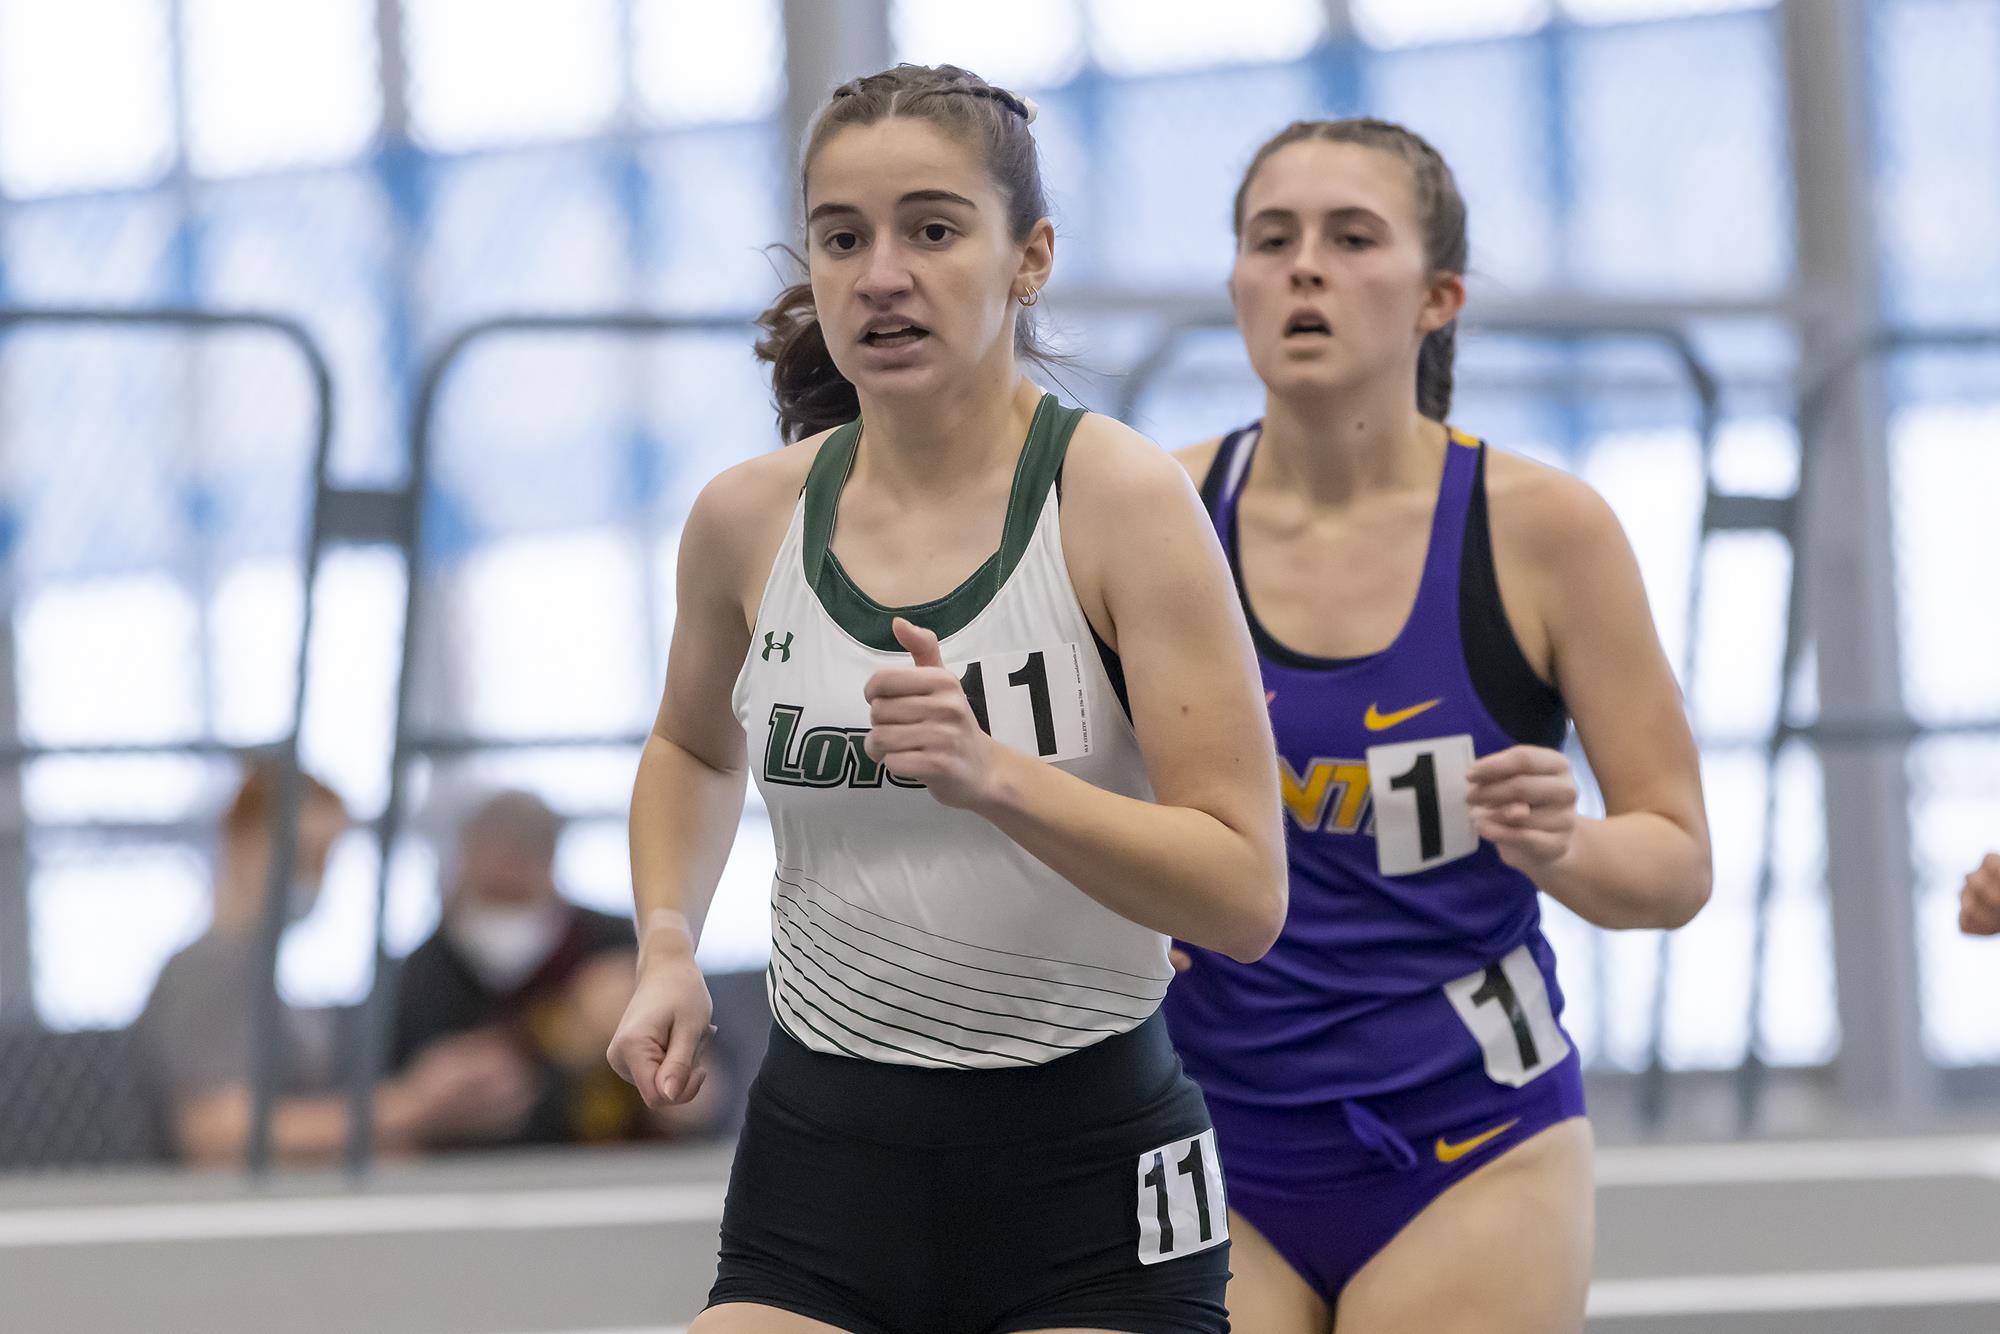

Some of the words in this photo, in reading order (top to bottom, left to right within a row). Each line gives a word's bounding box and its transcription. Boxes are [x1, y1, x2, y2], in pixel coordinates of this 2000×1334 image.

[764, 703, 928, 789] LOY
[1390, 752, 1444, 862] 1
[1471, 962, 1540, 1070] 1
[1145, 1139, 1213, 1254] 11
